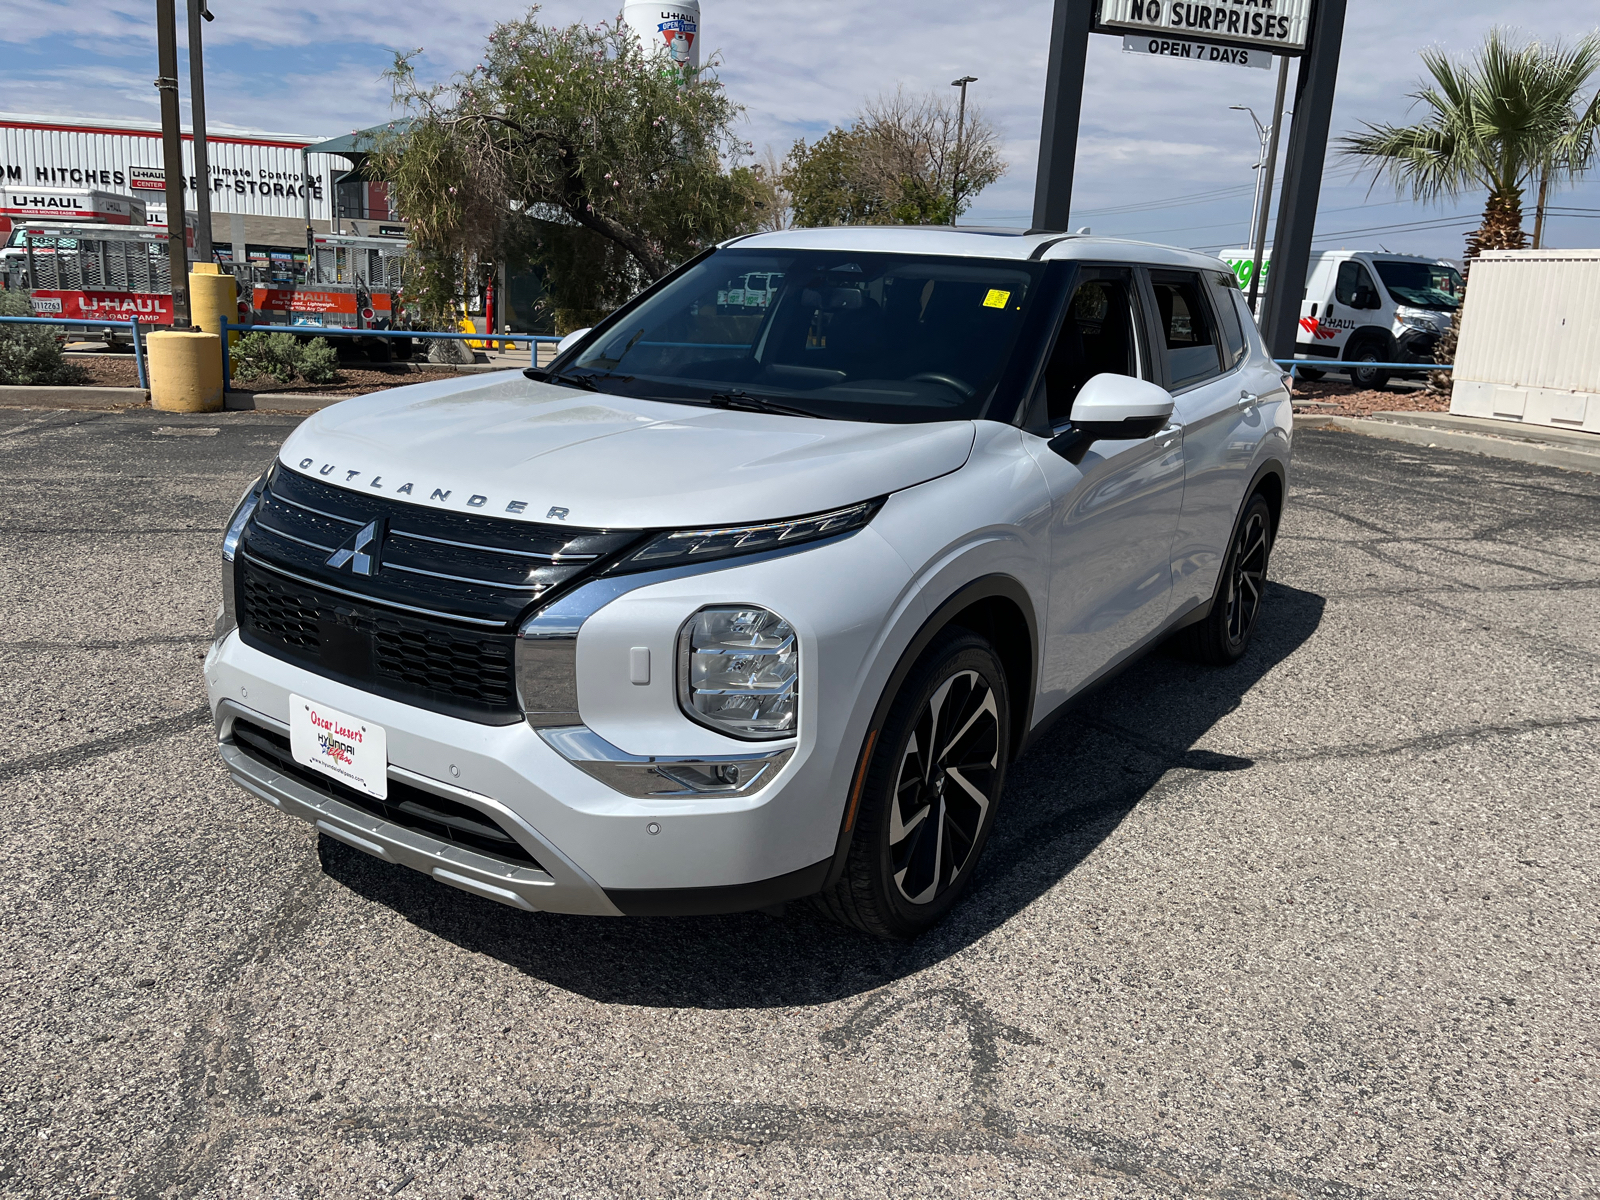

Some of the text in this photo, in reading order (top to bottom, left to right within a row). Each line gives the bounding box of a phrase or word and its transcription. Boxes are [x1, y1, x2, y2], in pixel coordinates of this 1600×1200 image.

[661, 12, 695, 23] U-HAUL
[1131, 0, 1289, 39] NO SURPRISES
[663, 22, 679, 30] OPEN
[1148, 39, 1249, 65] OPEN 7 DAYS
[36, 166, 125, 185] HITCHES
[136, 180, 163, 188] CENTER
[12, 195, 83, 209] U-HAUL
[271, 252, 292, 260] HITCHES
[279, 291, 332, 302] U-HAUL
[78, 297, 167, 313] U-HAUL
[1318, 316, 1356, 330] U-HAUL
[298, 457, 571, 522] OUTLANDER
[310, 710, 364, 744] Oscar Leeser's
[317, 732, 356, 756] HYUNDAI
